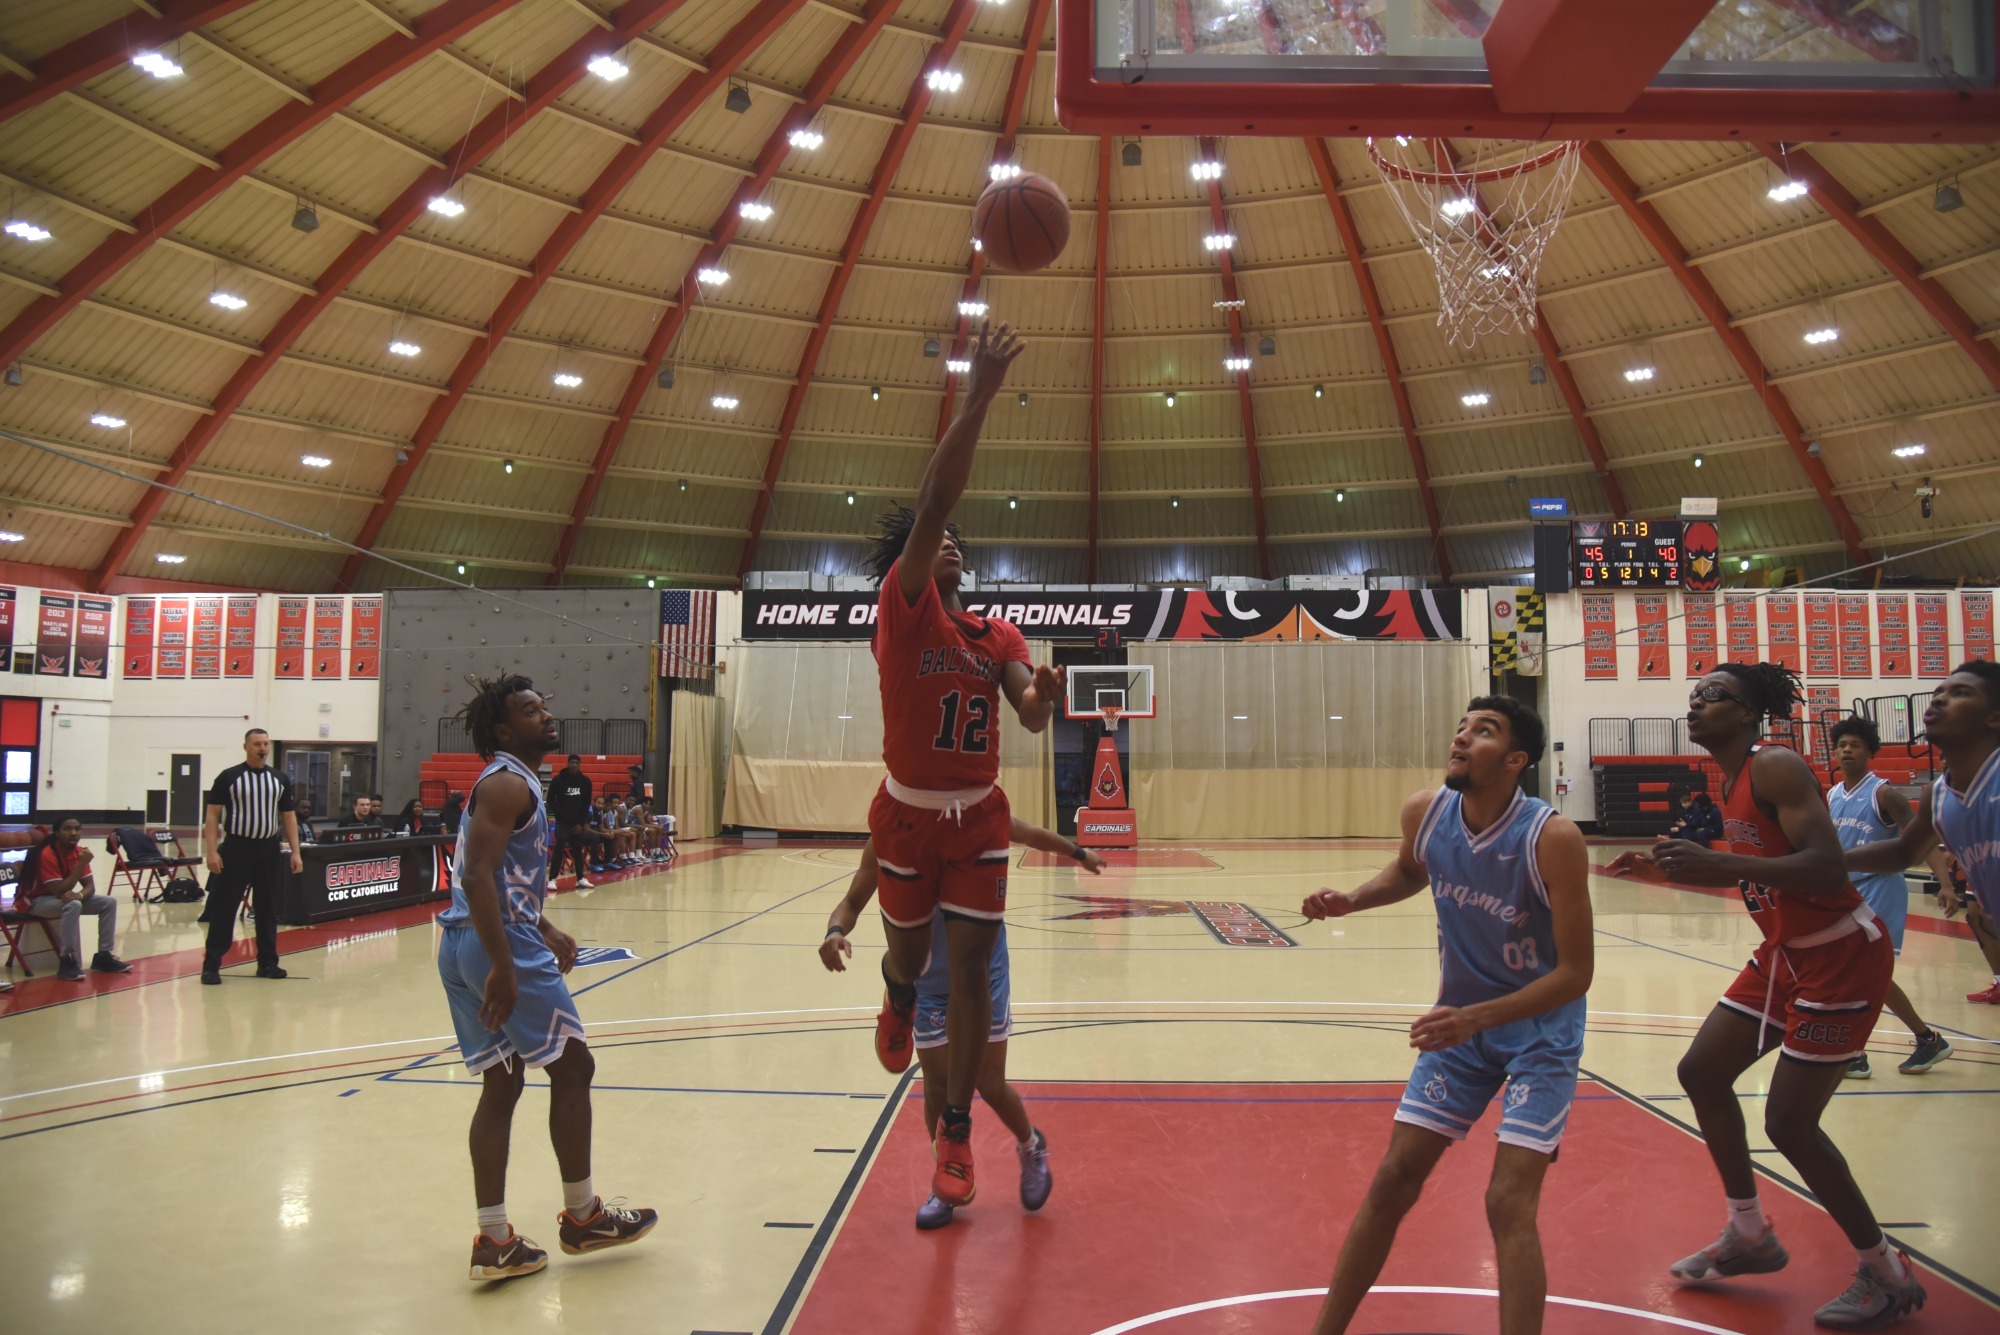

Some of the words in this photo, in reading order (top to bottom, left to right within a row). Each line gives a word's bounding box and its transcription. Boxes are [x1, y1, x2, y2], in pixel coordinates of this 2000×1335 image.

[1613, 522, 1648, 536] 17:13
[1585, 547, 1604, 560] 45
[1658, 547, 1676, 560] 40
[1585, 568, 1592, 578] 0
[1601, 568, 1608, 578] 5
[1620, 568, 1630, 578] 12
[1650, 568, 1658, 578] 4
[1670, 568, 1676, 578] 2
[47, 609, 66, 618] 2013
[85, 612, 103, 620] 2012
[756, 604, 839, 625] HOME
[1098, 630, 1118, 647] 21
[933, 690, 990, 754] 12
[155, 832, 173, 841] CCBC
[328, 860, 398, 886] CARDINALS
[328, 890, 349, 902] CCBC
[351, 882, 398, 898] CATONSVILLE
[1429, 873, 1530, 928] ingsmen
[1503, 937, 1538, 970] 03
[1796, 1022, 1850, 1044] BCCC
